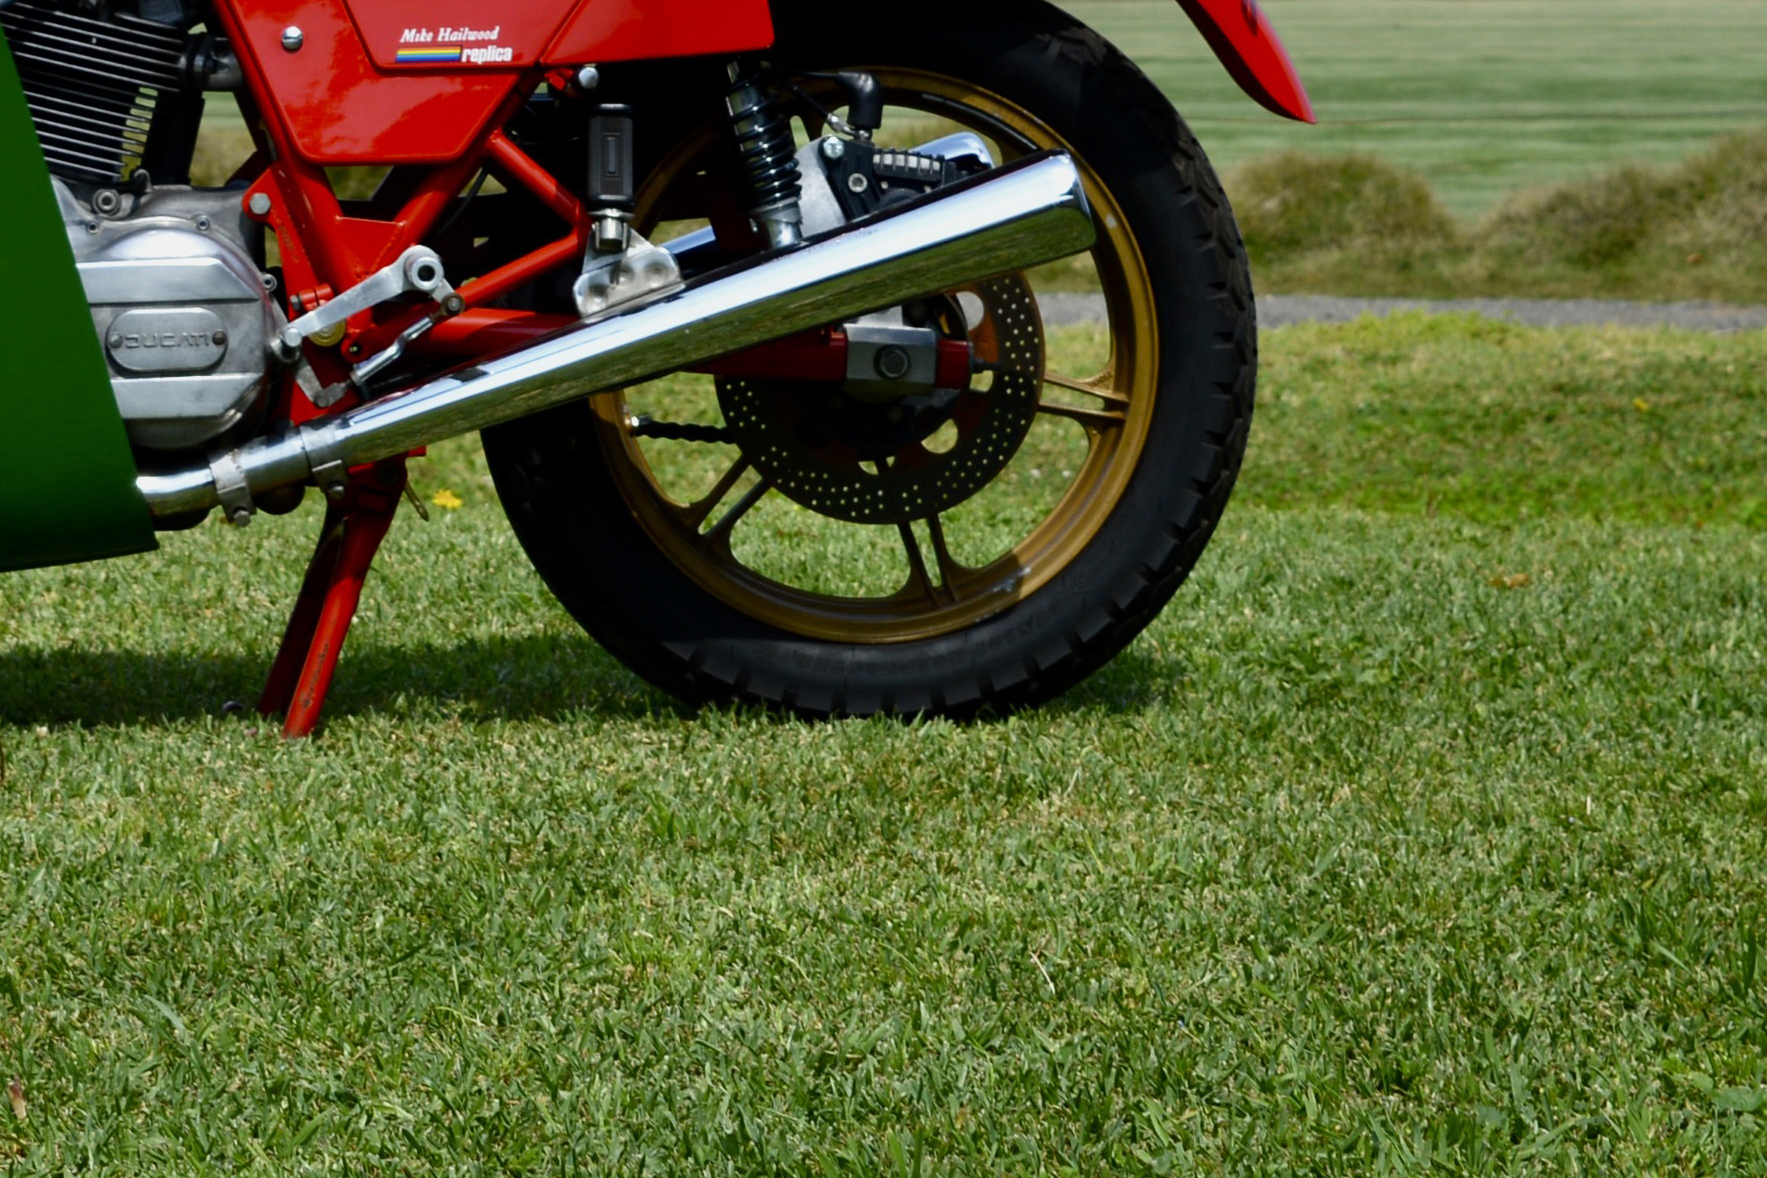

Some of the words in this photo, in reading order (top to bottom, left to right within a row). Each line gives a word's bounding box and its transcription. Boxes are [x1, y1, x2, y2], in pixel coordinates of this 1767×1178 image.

[400, 28, 433, 43] Mike
[437, 25, 500, 42] Hailwood
[461, 44, 513, 64] replica
[124, 332, 211, 349] DUCATI
